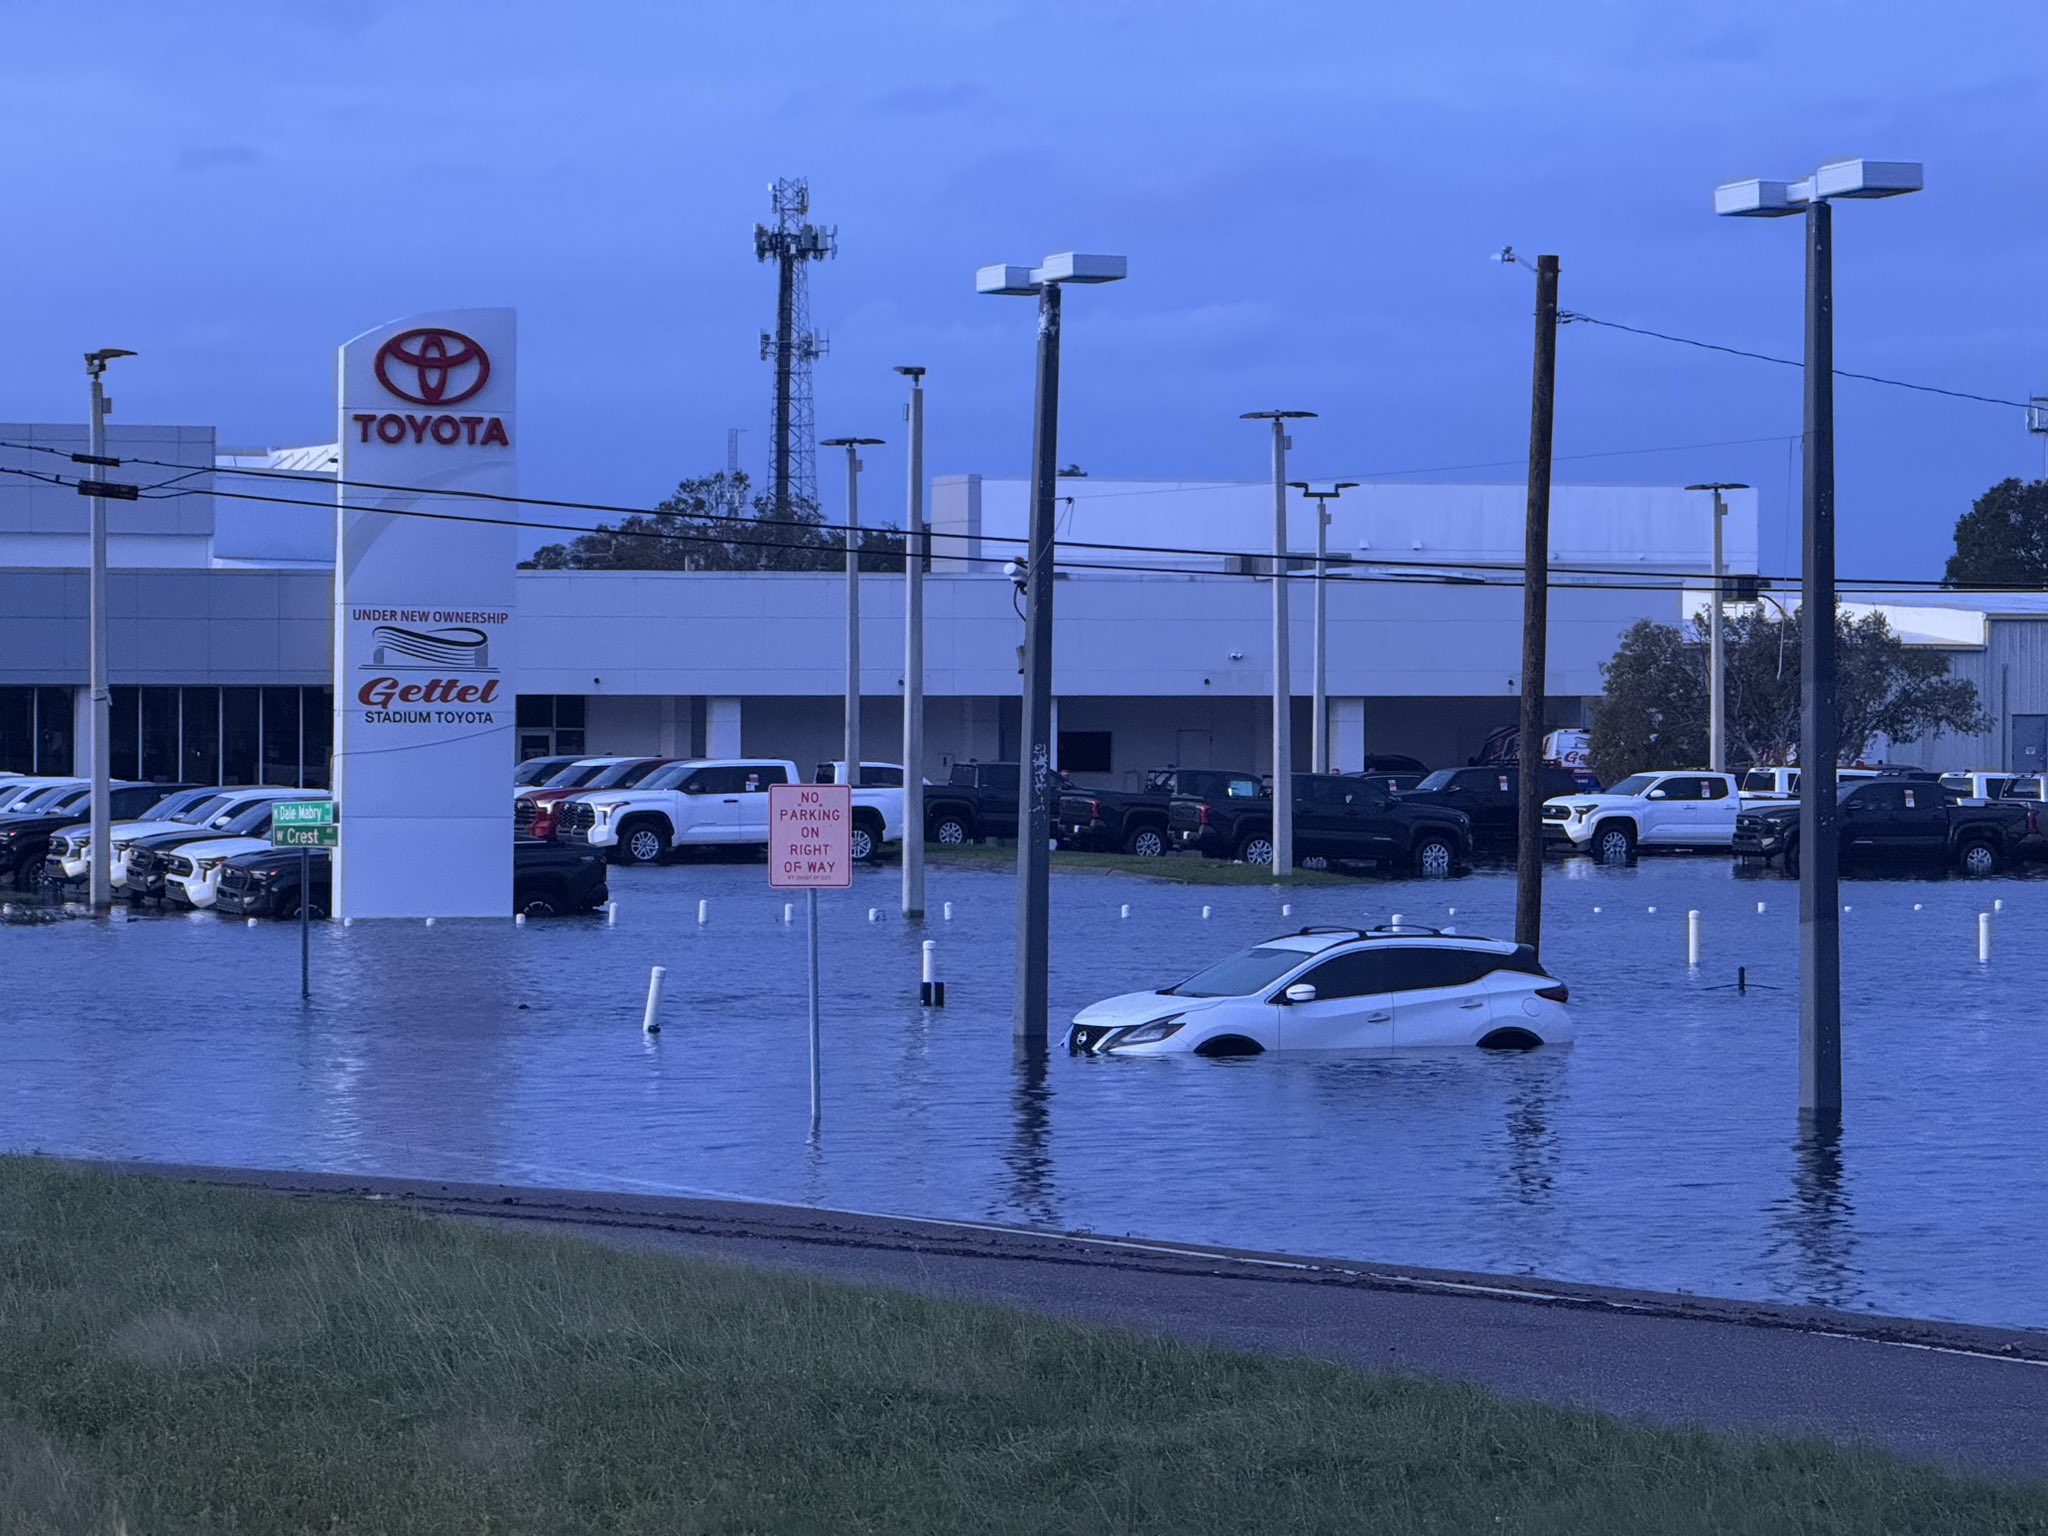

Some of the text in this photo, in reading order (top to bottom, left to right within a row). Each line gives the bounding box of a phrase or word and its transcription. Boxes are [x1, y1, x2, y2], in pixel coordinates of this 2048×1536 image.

[352, 413, 509, 447] TOYOTA
[352, 609, 509, 624] UNDER NEW OWNERSHIP
[357, 676, 500, 710] Gettel
[364, 711, 494, 724] STADIUM TOYOTA
[801, 791, 819, 804] NO
[280, 805, 297, 820] Dale
[298, 804, 322, 822] Mabry
[780, 809, 841, 821] PARKING
[276, 830, 284, 841] W
[287, 827, 319, 844] Crest
[801, 826, 820, 838] ON
[790, 844, 830, 856] RIGHT
[784, 861, 836, 873] OF WAY
